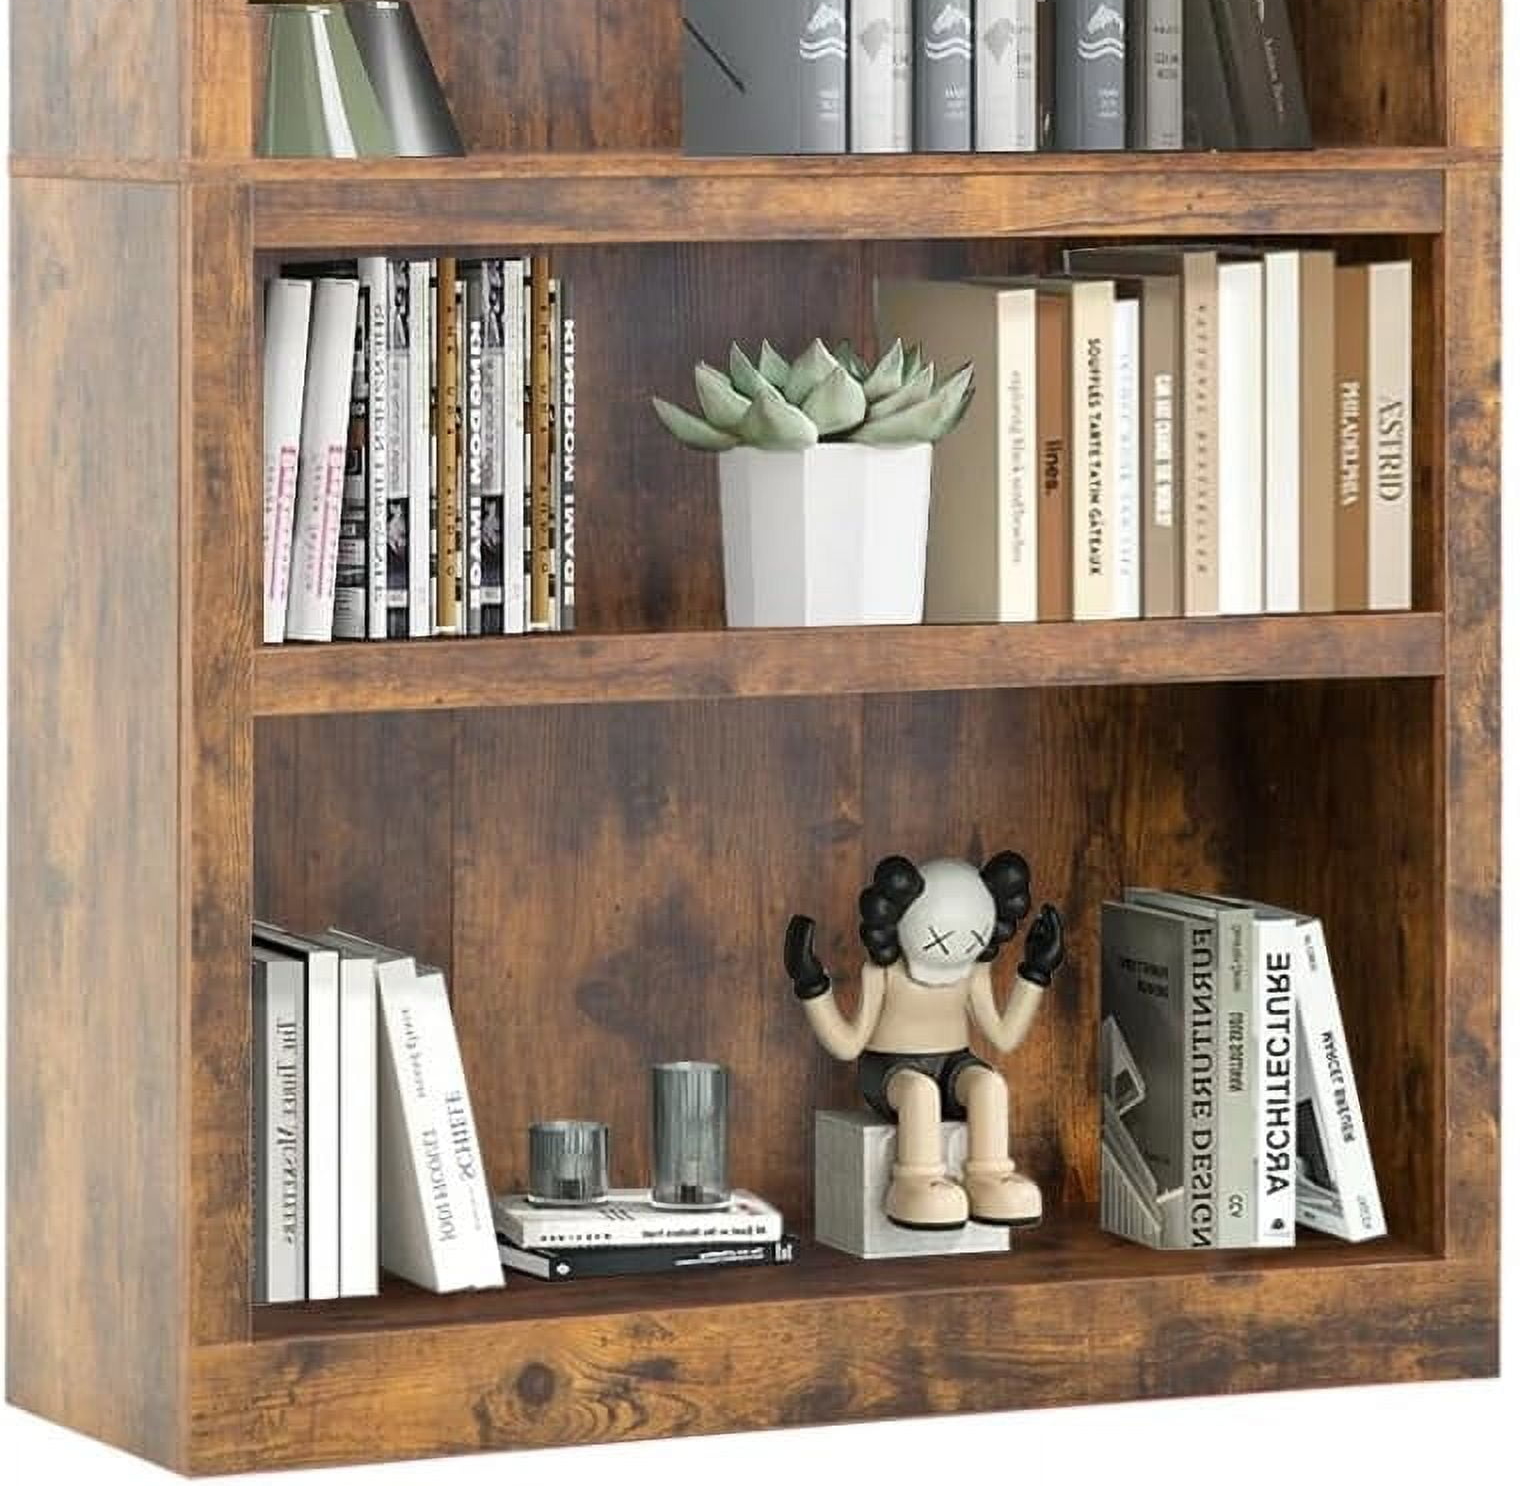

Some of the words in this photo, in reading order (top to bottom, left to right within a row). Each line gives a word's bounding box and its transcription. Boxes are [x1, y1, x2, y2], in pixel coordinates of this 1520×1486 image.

[1088, 412, 1100, 456] TARTE
[1340, 381, 1360, 507] PHILADELPHIA
[1378, 400, 1404, 501] ASTRID
[1088, 461, 1100, 504] TATIN
